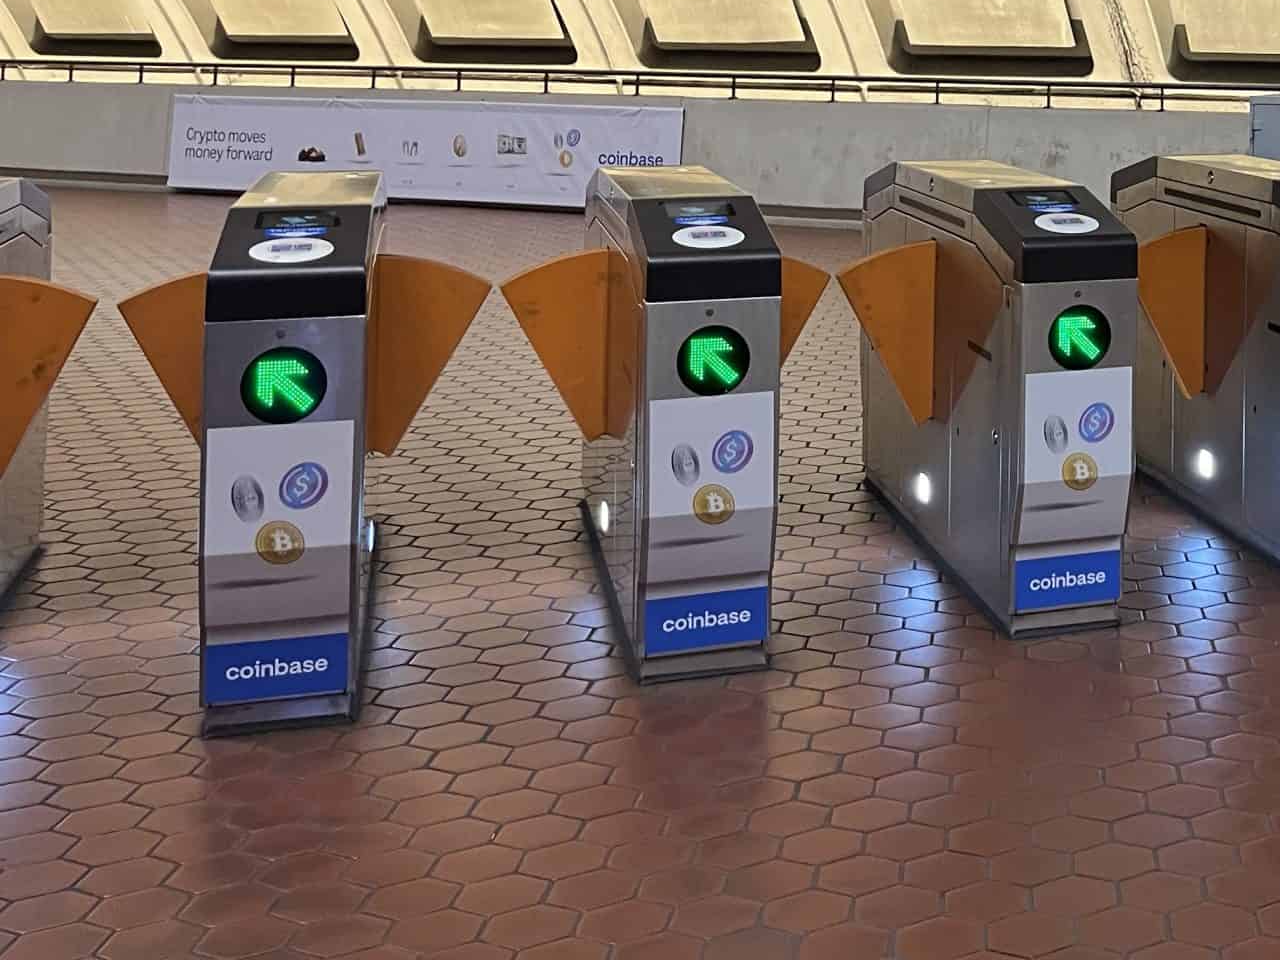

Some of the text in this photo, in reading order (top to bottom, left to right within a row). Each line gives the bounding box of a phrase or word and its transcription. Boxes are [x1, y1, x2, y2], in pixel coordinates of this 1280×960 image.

[186, 127, 266, 145] Crypto moves
[185, 146, 273, 162] money forward
[598, 151, 664, 166] coinbase
[1030, 568, 1106, 591] coinbase
[662, 608, 751, 632] coinbase
[225, 655, 328, 681] coinbase
